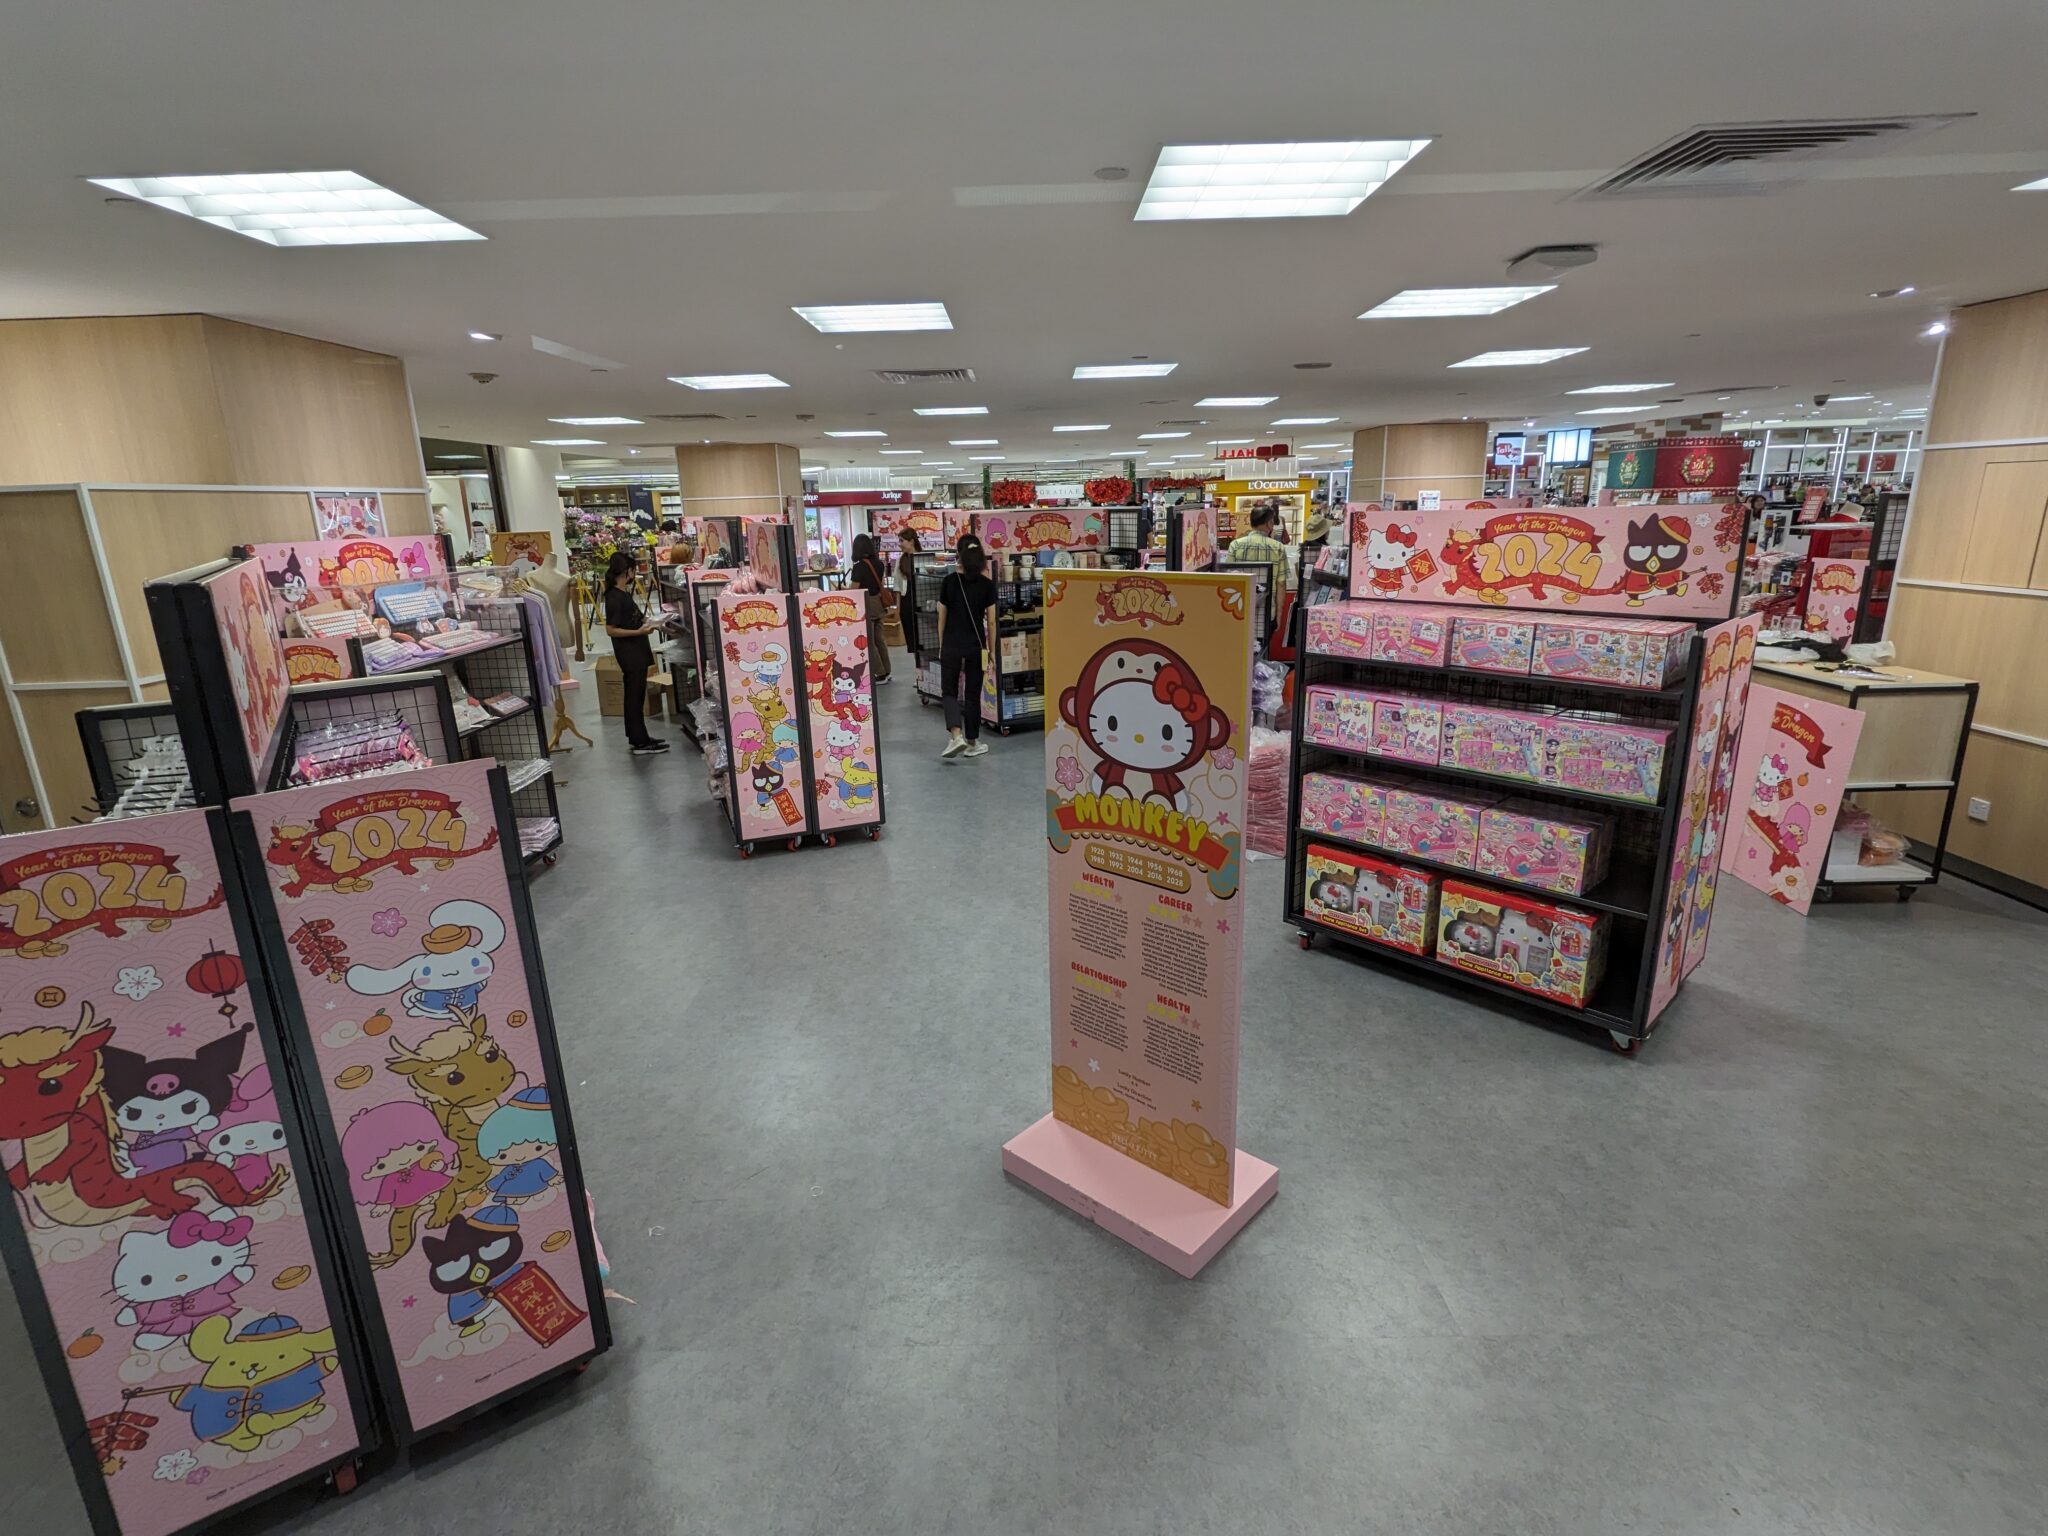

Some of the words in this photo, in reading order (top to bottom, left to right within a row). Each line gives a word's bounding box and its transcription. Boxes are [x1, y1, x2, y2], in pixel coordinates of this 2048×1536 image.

[1248, 481, 1299, 490] L'OCCITANE
[1028, 523, 1071, 544] 2024
[1494, 523, 1515, 533] Year
[1519, 520, 1529, 531] of
[1531, 519, 1546, 529] the
[1547, 521, 1586, 537] Dragon
[1412, 558, 1431, 575] 福
[1477, 532, 1603, 589] 2024
[817, 603, 857, 621] 2024
[1113, 588, 1171, 621] 2024
[736, 608, 779, 628] 2024
[288, 655, 342, 681] 2024
[1781, 716, 1815, 743] Dragon
[332, 806, 359, 821] Year
[363, 800, 375, 813] of
[378, 798, 394, 808] the
[398, 796, 440, 807] Dragon
[1074, 792, 1208, 852] MONKEY
[318, 806, 467, 874] 2024
[15, 861, 49, 877] Year
[54, 855, 69, 868] of
[72, 852, 95, 865] the
[98, 850, 154, 863] Dragon
[1091, 846, 1105, 855] 1920
[1109, 851, 1124, 861] 1932
[1127, 856, 1143, 866] 1944
[1148, 861, 1162, 872] 1956
[1167, 866, 1183, 877] 1968
[1109, 860, 1124, 870] 1992
[1127, 865, 1143, 876] 2004
[1148, 871, 1162, 881] 2016
[1167, 876, 1184, 887] 2028
[1082, 872, 1115, 889] WEALTH
[0, 862, 187, 937] 2024
[1158, 894, 1193, 912] CAREER
[1071, 962, 1128, 989] RELATIONSHIP
[1459, 959, 1472, 968] Home
[1474, 964, 1502, 977] Appliance
[1502, 972, 1513, 981] Set
[1156, 994, 1191, 1014] HEALTH
